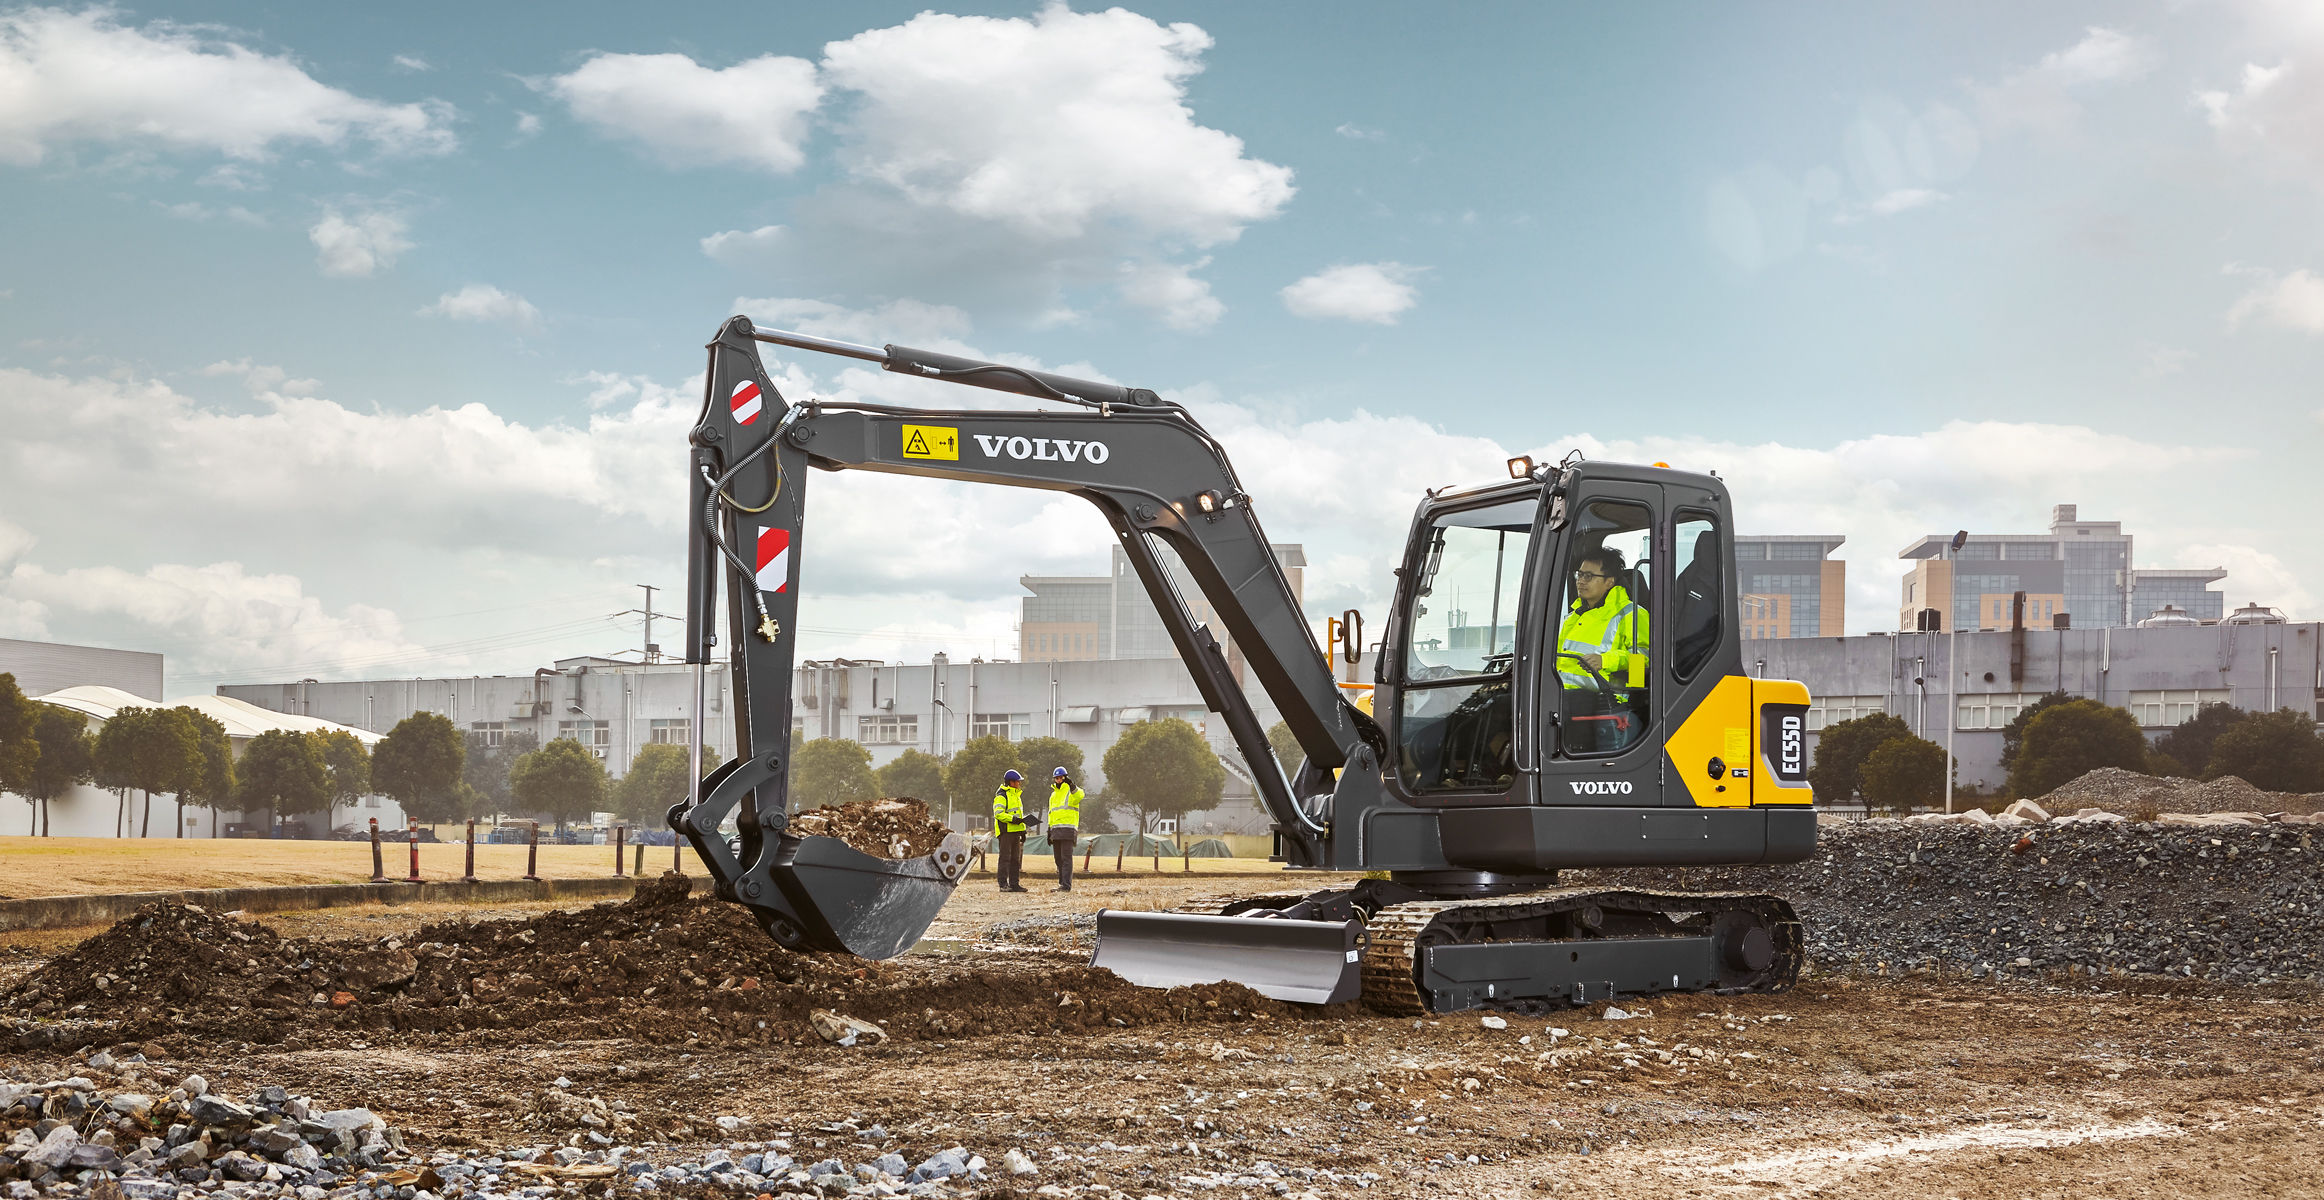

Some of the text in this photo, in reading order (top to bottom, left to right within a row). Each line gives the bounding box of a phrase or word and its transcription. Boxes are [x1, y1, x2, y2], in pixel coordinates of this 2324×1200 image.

[973, 434, 1109, 465] VOLVO
[1782, 716, 1801, 774] EC55D
[1569, 781, 1633, 795] VOLVO
